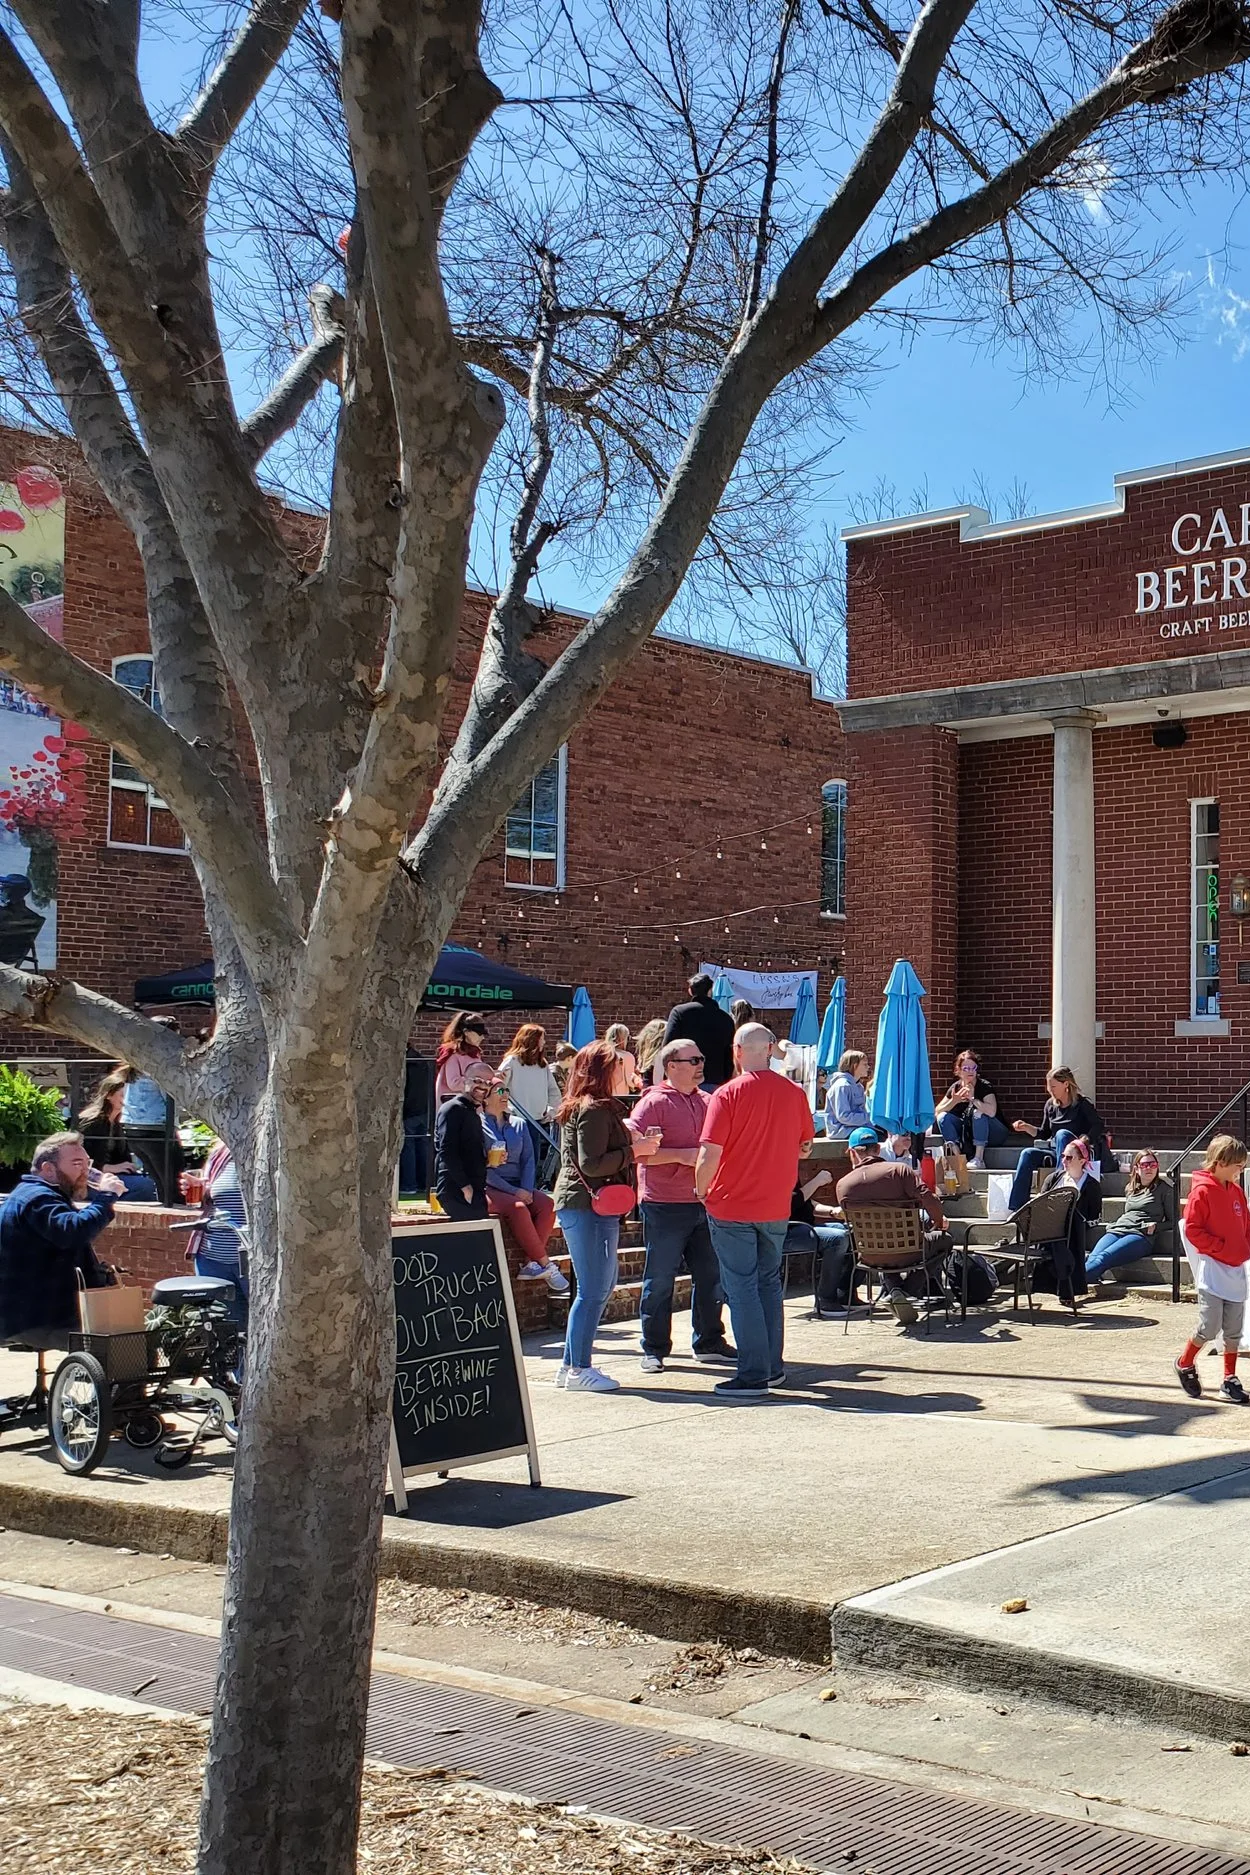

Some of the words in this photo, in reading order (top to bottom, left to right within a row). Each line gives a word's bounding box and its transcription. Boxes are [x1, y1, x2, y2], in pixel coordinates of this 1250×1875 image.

[1134, 557, 1250, 613] BEER
[1159, 616, 1213, 638] CRAFT
[171, 982, 214, 997] canno
[392, 1251, 439, 1286] OOD
[414, 1263, 497, 1305] TRUCKS
[450, 1298, 505, 1342] BACK
[395, 1360, 452, 1406] BEER
[405, 1385, 490, 1435] INSIDE!
